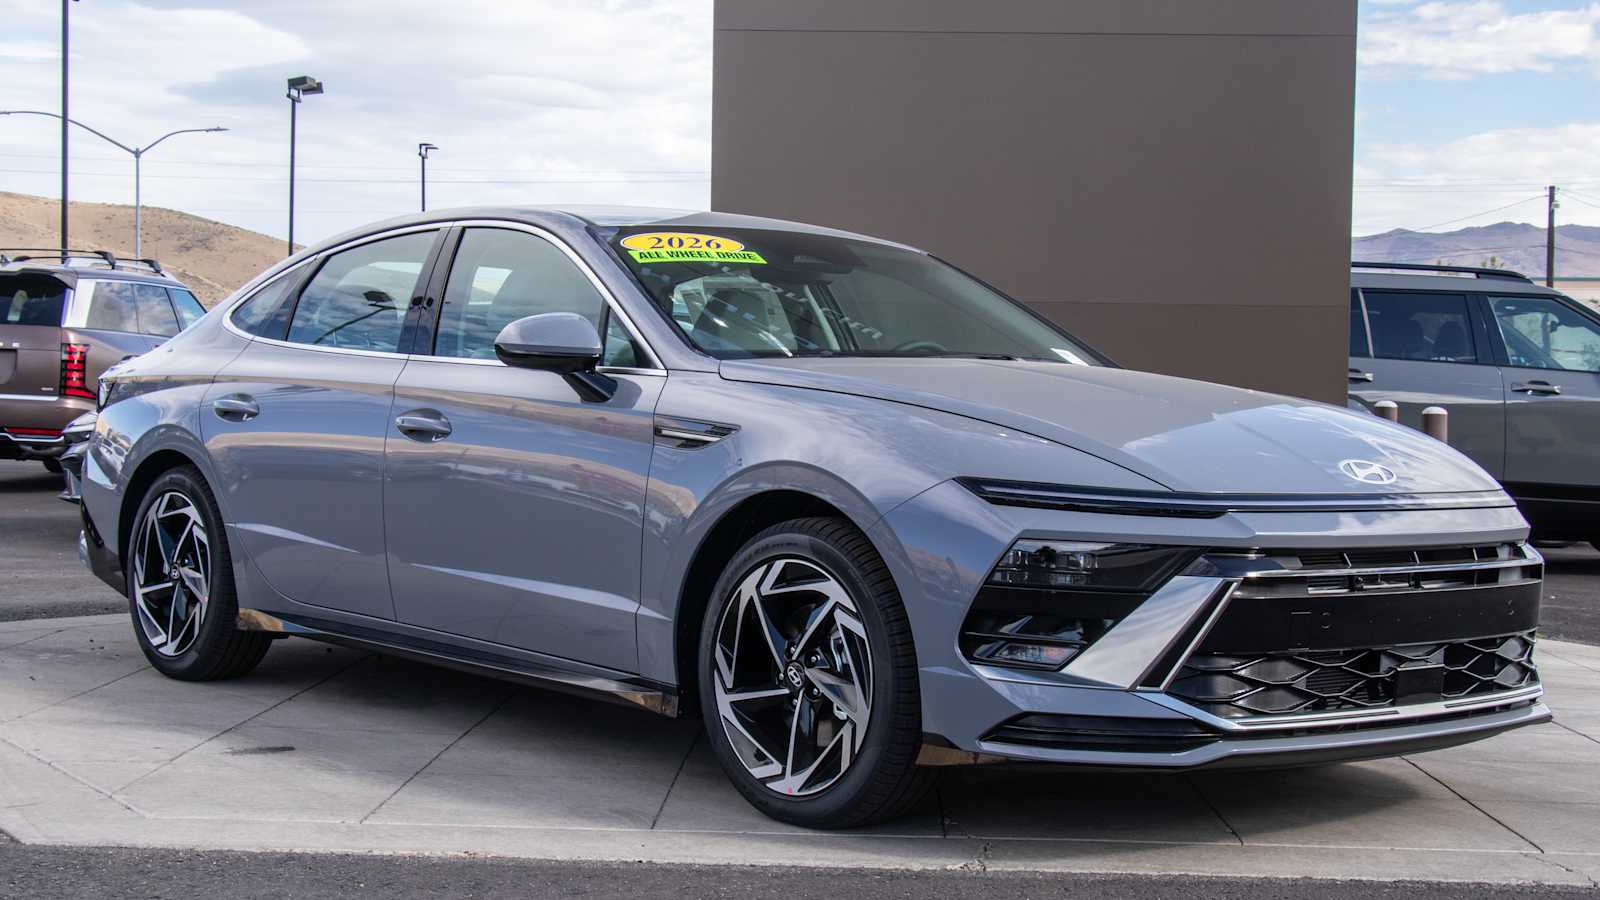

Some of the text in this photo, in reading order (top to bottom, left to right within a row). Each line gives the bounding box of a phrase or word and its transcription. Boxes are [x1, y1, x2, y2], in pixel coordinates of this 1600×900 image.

[648, 236, 721, 249] 2026
[639, 250, 758, 260] ALL WHEEL DRIVE
